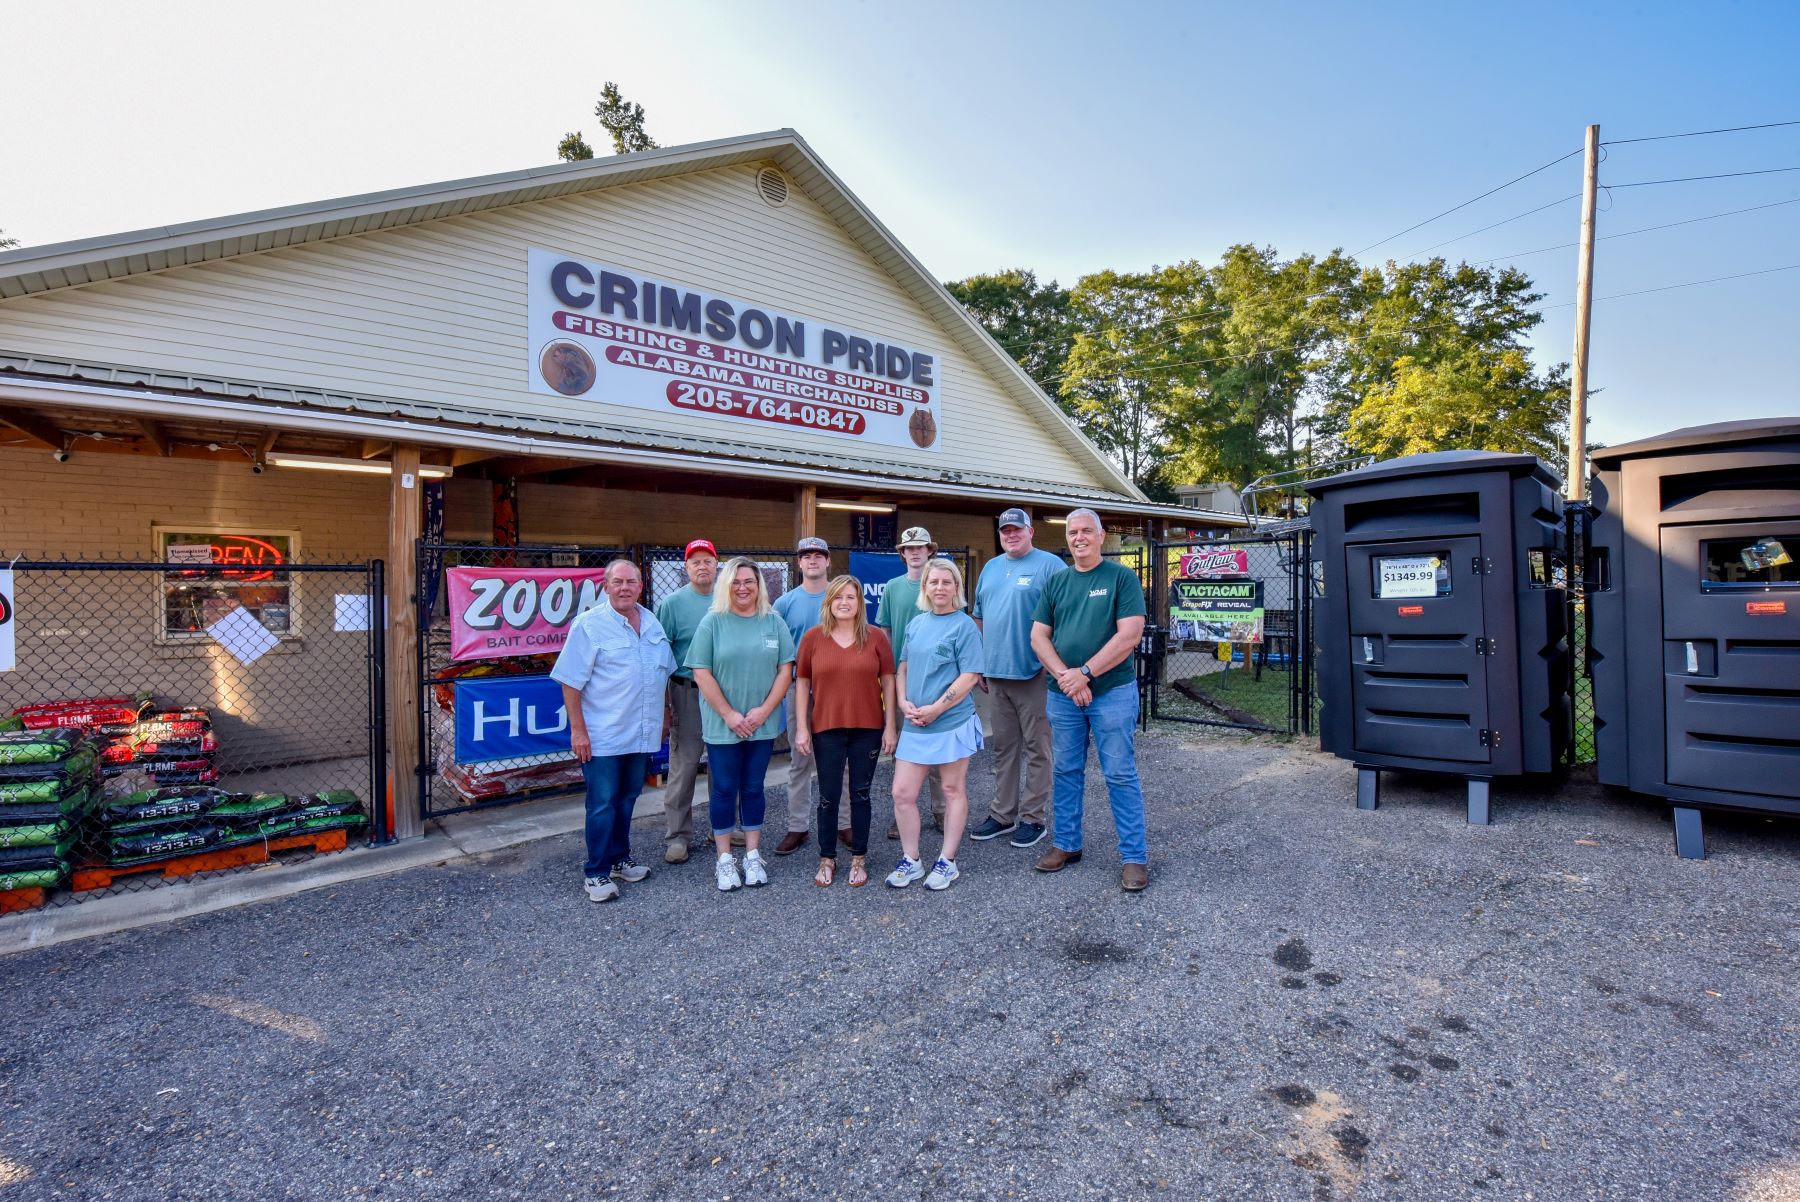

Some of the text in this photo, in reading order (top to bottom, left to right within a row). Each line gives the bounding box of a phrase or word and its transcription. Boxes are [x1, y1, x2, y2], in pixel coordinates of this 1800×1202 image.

[551, 261, 933, 387] CRIMSON PRIDE
[565, 315, 923, 401] FISHING & HUNTING SUPPLIES
[617, 350, 898, 413] ALABAMA MERCHANDISE
[677, 383, 859, 431] 205-764-0847
[1384, 572, 1433, 582] $1349.99
[1182, 585, 1250, 597] TACTACAM
[487, 633, 568, 649] BAIT COMP
[139, 802, 201, 819] 13-13-13
[145, 837, 205, 854] 13-13-13
